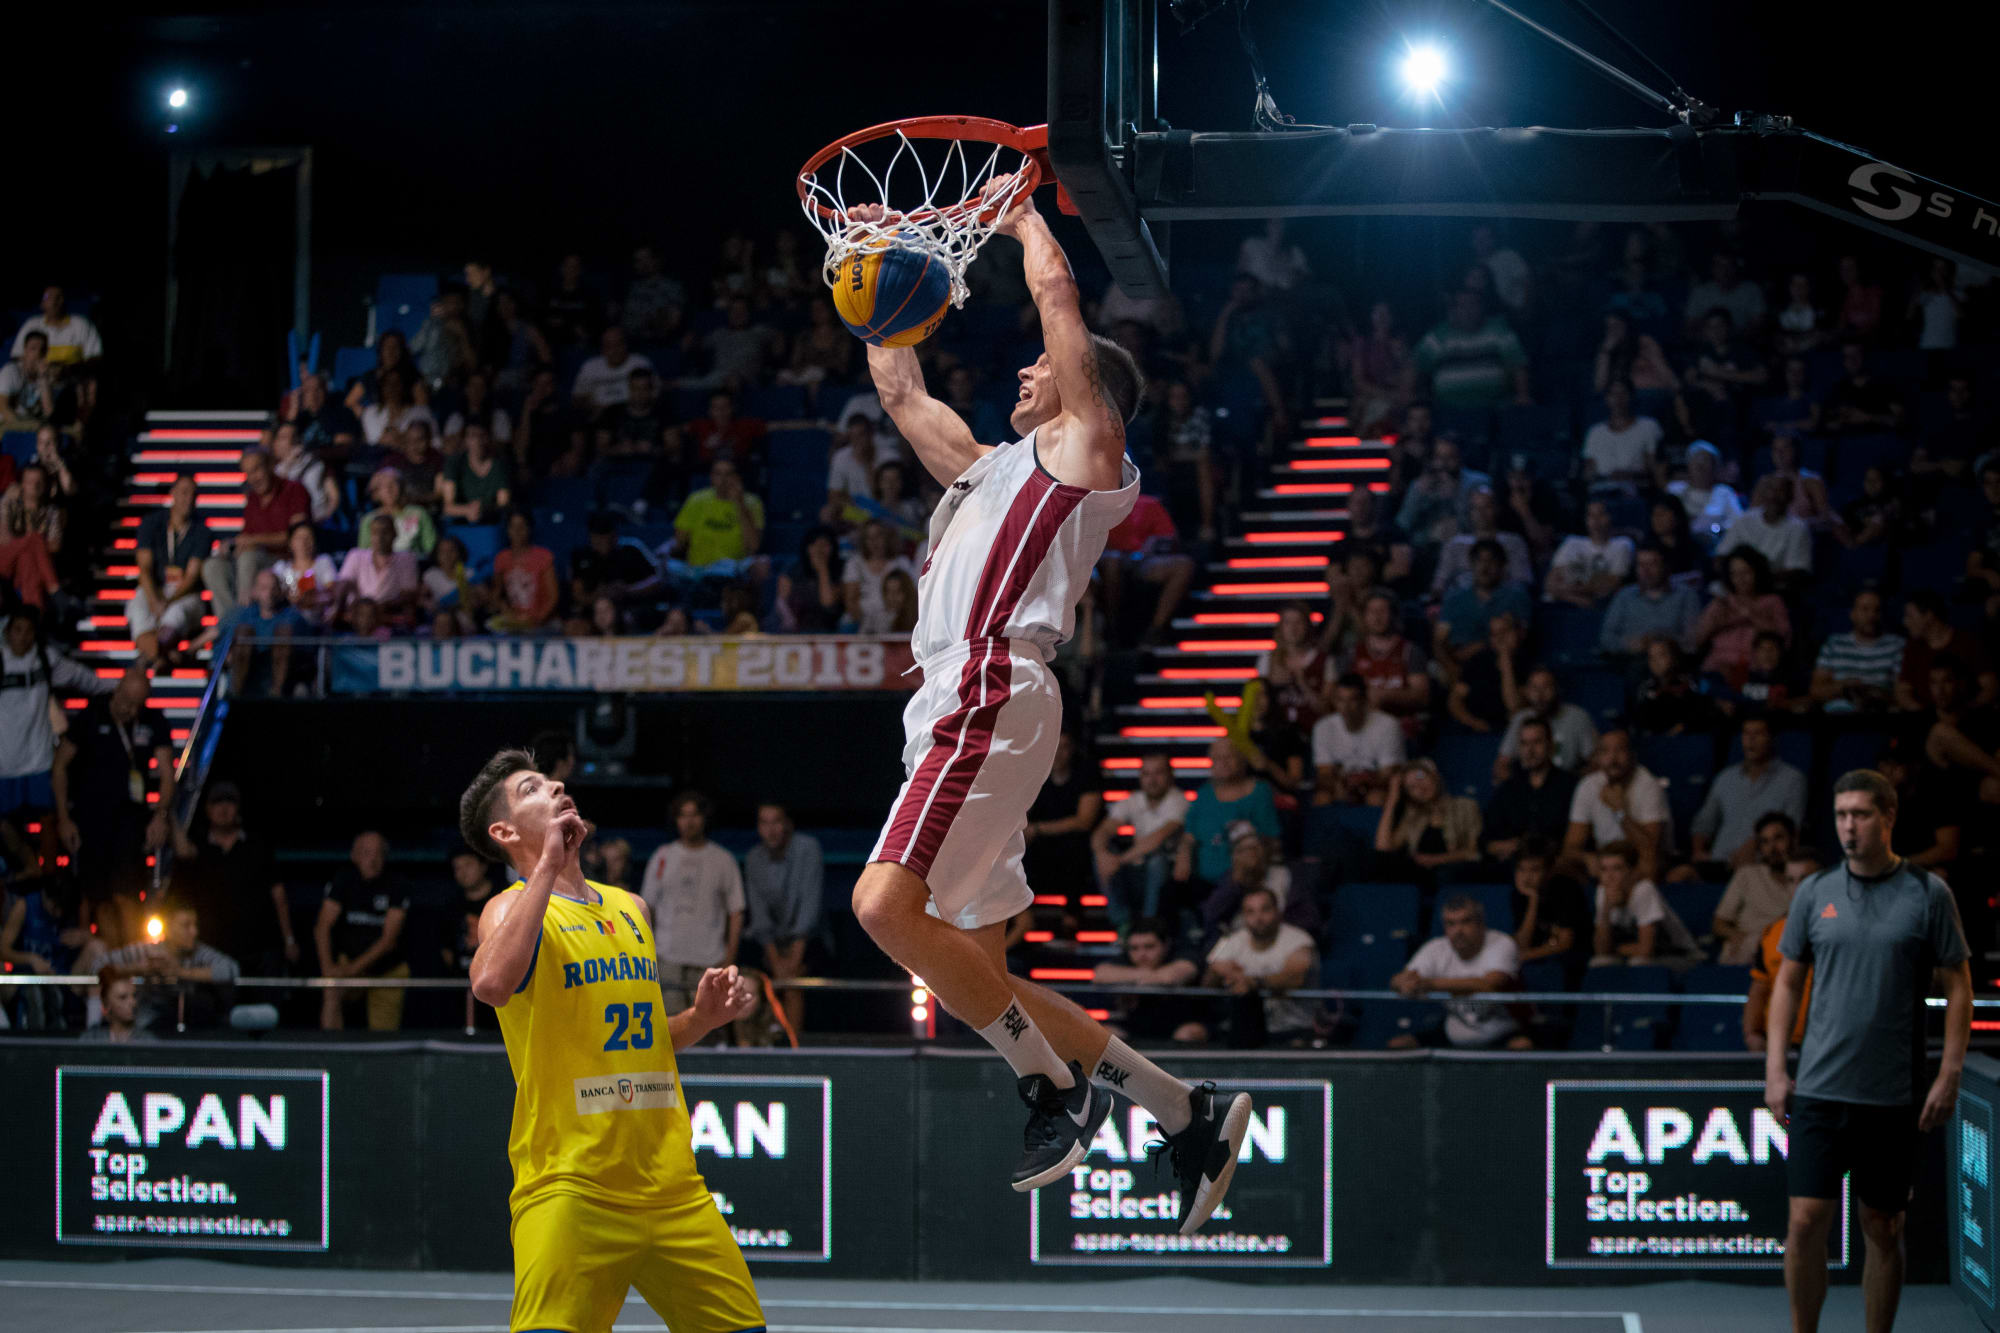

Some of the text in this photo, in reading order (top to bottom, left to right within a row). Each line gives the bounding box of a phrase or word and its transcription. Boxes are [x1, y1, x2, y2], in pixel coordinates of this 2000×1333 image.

[377, 641, 885, 690] BUCHAREST 2018
[603, 1002, 654, 1052] 23
[1001, 1004, 1029, 1041] PEAK
[1097, 1061, 1130, 1089] PEAK
[581, 1086, 615, 1098] BANCA
[91, 1091, 287, 1150] APAN
[88, 1149, 149, 1178] Top
[91, 1174, 238, 1204] Selection.
[1070, 1164, 1135, 1194] Top
[1583, 1167, 1652, 1196] Top
[1587, 1193, 1750, 1222] Selection.
[1588, 1235, 1787, 1258] apan-topselection.
